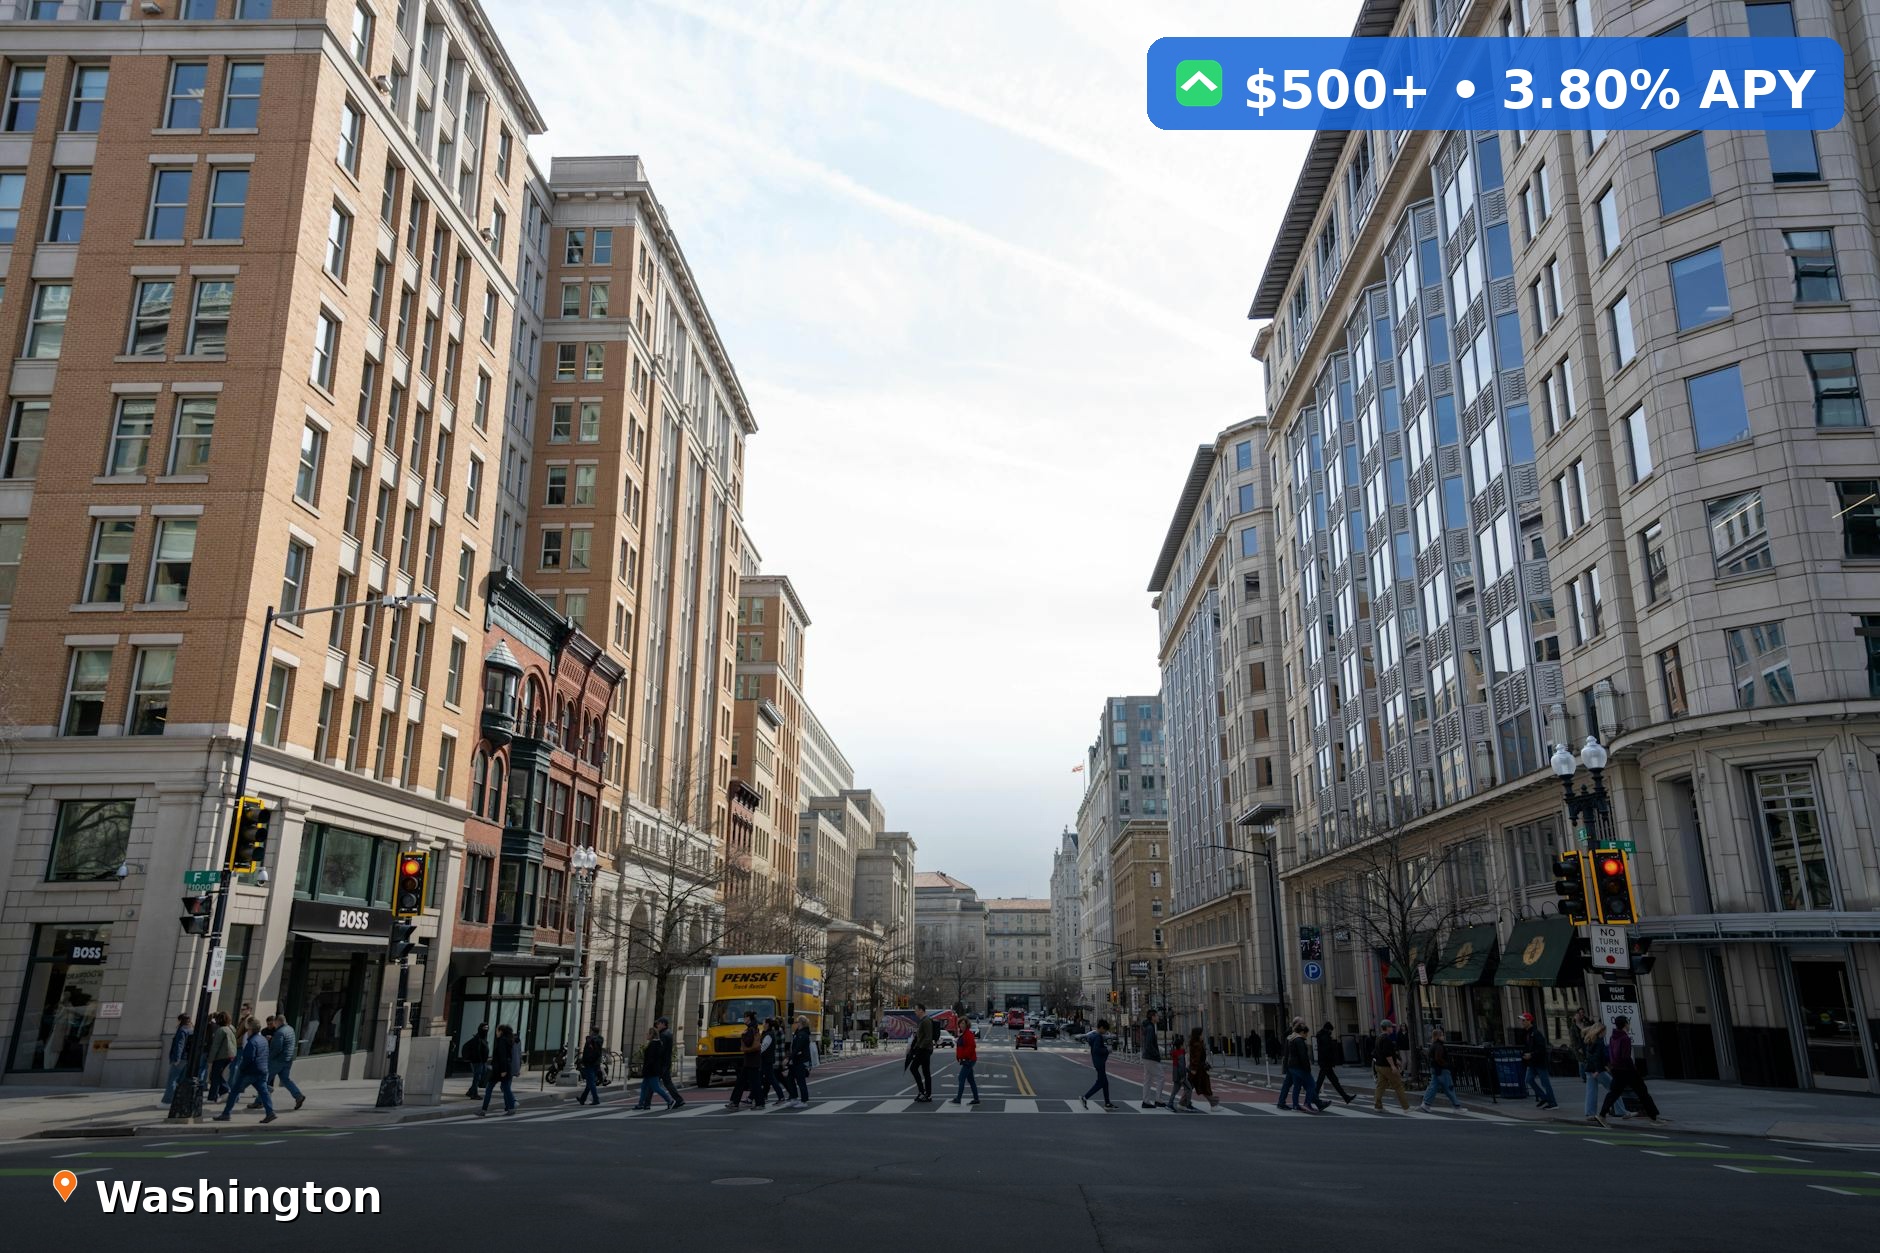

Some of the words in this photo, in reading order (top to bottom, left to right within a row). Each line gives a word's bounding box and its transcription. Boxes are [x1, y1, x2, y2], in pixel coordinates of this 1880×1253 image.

[193, 872, 202, 883] F
[338, 909, 370, 930] BOSS
[1600, 928, 1615, 937] NO
[1599, 938, 1619, 946] TURN
[72, 946, 102, 959] BOSS
[1609, 947, 1624, 955] RED
[721, 972, 780, 983] PENSKE
[1606, 1005, 1634, 1014] BUSES
